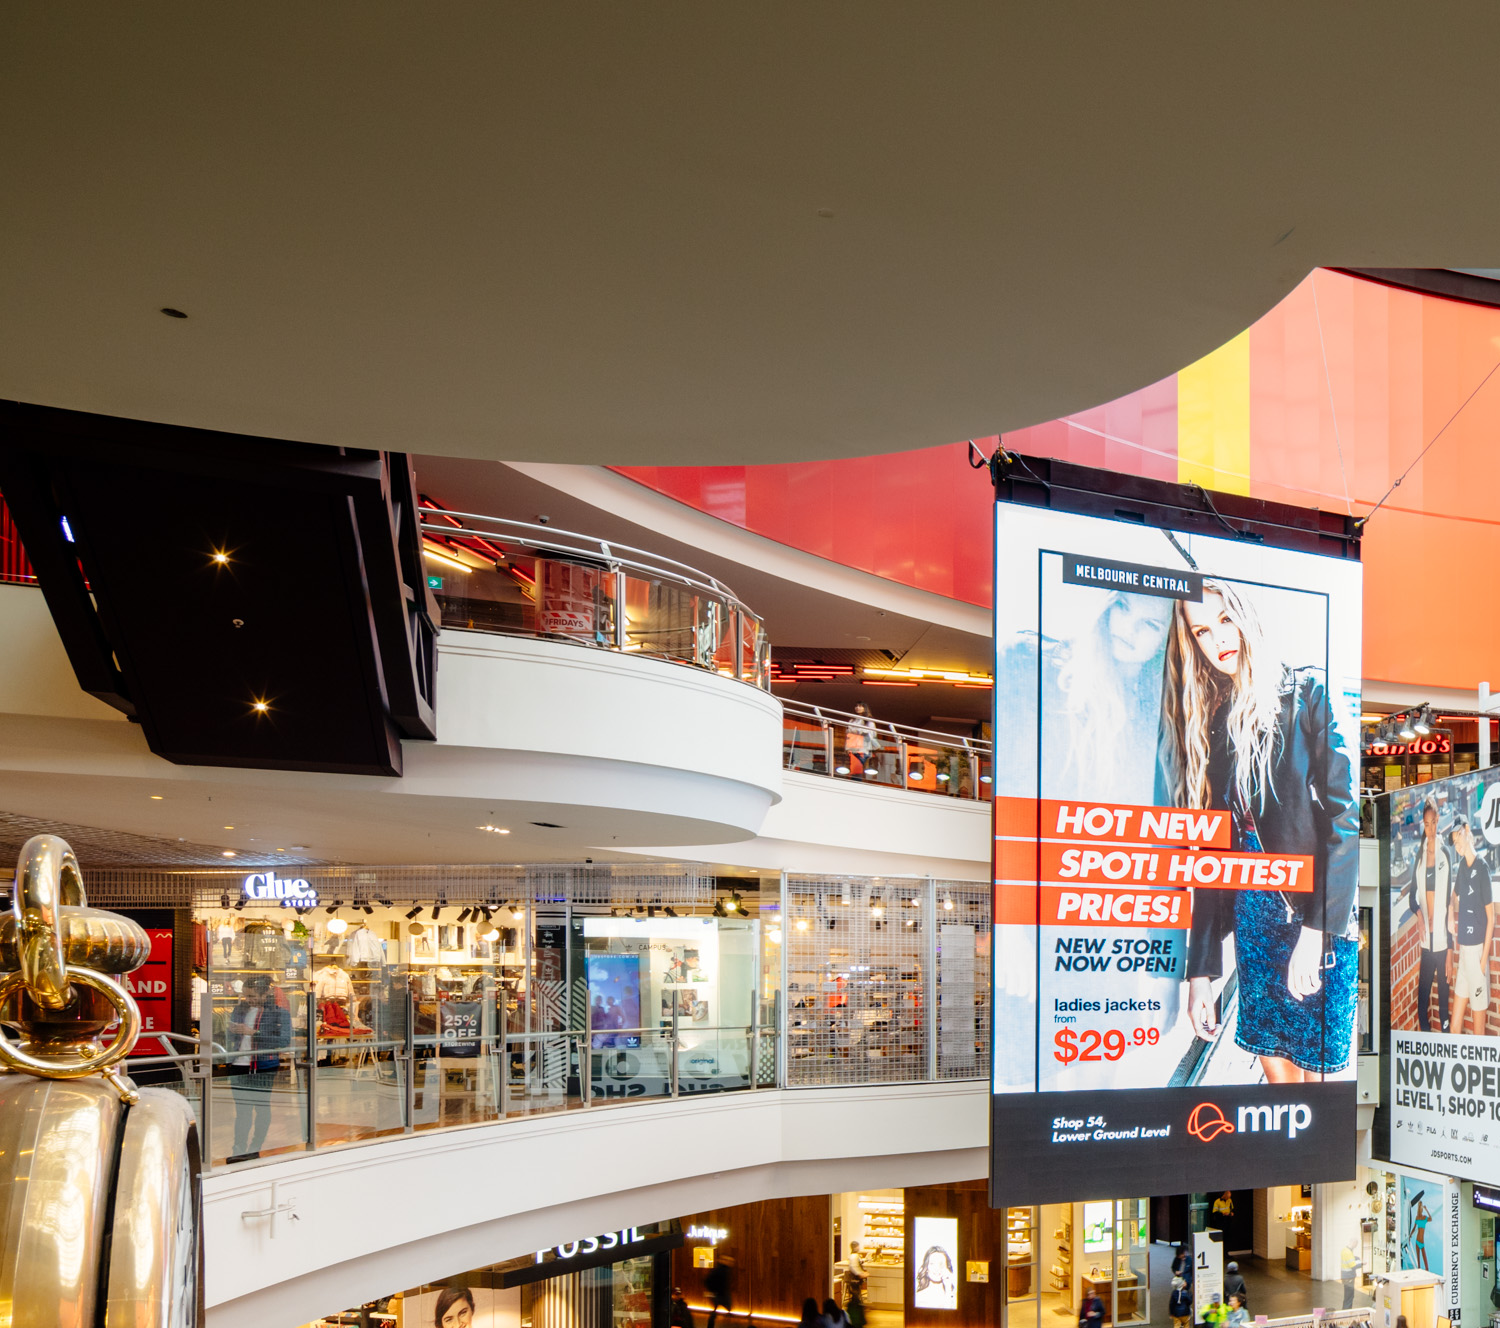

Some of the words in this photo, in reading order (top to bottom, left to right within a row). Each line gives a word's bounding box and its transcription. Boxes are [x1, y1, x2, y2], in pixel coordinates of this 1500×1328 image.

[1076, 564, 1139, 586] MELBOURNE
[1143, 574, 1191, 593] CENTRAL
[550, 618, 584, 628] FRIDAYS
[1366, 734, 1450, 756] ando's
[1056, 806, 1133, 837] HOT
[1140, 811, 1222, 842] NEW
[1058, 849, 1158, 881] SPOT!
[1168, 854, 1304, 887] HOTTEST
[284, 899, 317, 907] STORE
[1056, 892, 1182, 923] PRICES!
[1054, 938, 1106, 955] NEW
[1111, 938, 1173, 956] STORE
[1054, 956, 1112, 973] NOW
[1116, 956, 1177, 973] OPEN!
[1054, 998, 1100, 1012] ladies
[1105, 998, 1161, 1014] jackets
[444, 1014, 477, 1027] 25%
[1054, 1014, 1076, 1024] from
[444, 1028, 477, 1039] OFF
[1396, 1039, 1458, 1058] MELBOURNE
[1396, 1057, 1446, 1091] NOW
[1396, 1088, 1434, 1111] LEVEL
[1436, 1094, 1446, 1117] 1,
[1448, 1095, 1486, 1118] SHOP
[1052, 1117, 1084, 1131] Shop
[1086, 1116, 1107, 1130] 54,
[1237, 1102, 1312, 1139] mrp
[1052, 1129, 1091, 1144] Lower
[1094, 1127, 1138, 1141] Ground
[1140, 1124, 1171, 1139] Level
[1430, 1149, 1472, 1165] JDSPORTS.COM
[1451, 1192, 1459, 1247] EXCHANGE
[1197, 1251, 1209, 1269] 1
[1451, 1250, 1459, 1305] CURRENCY
